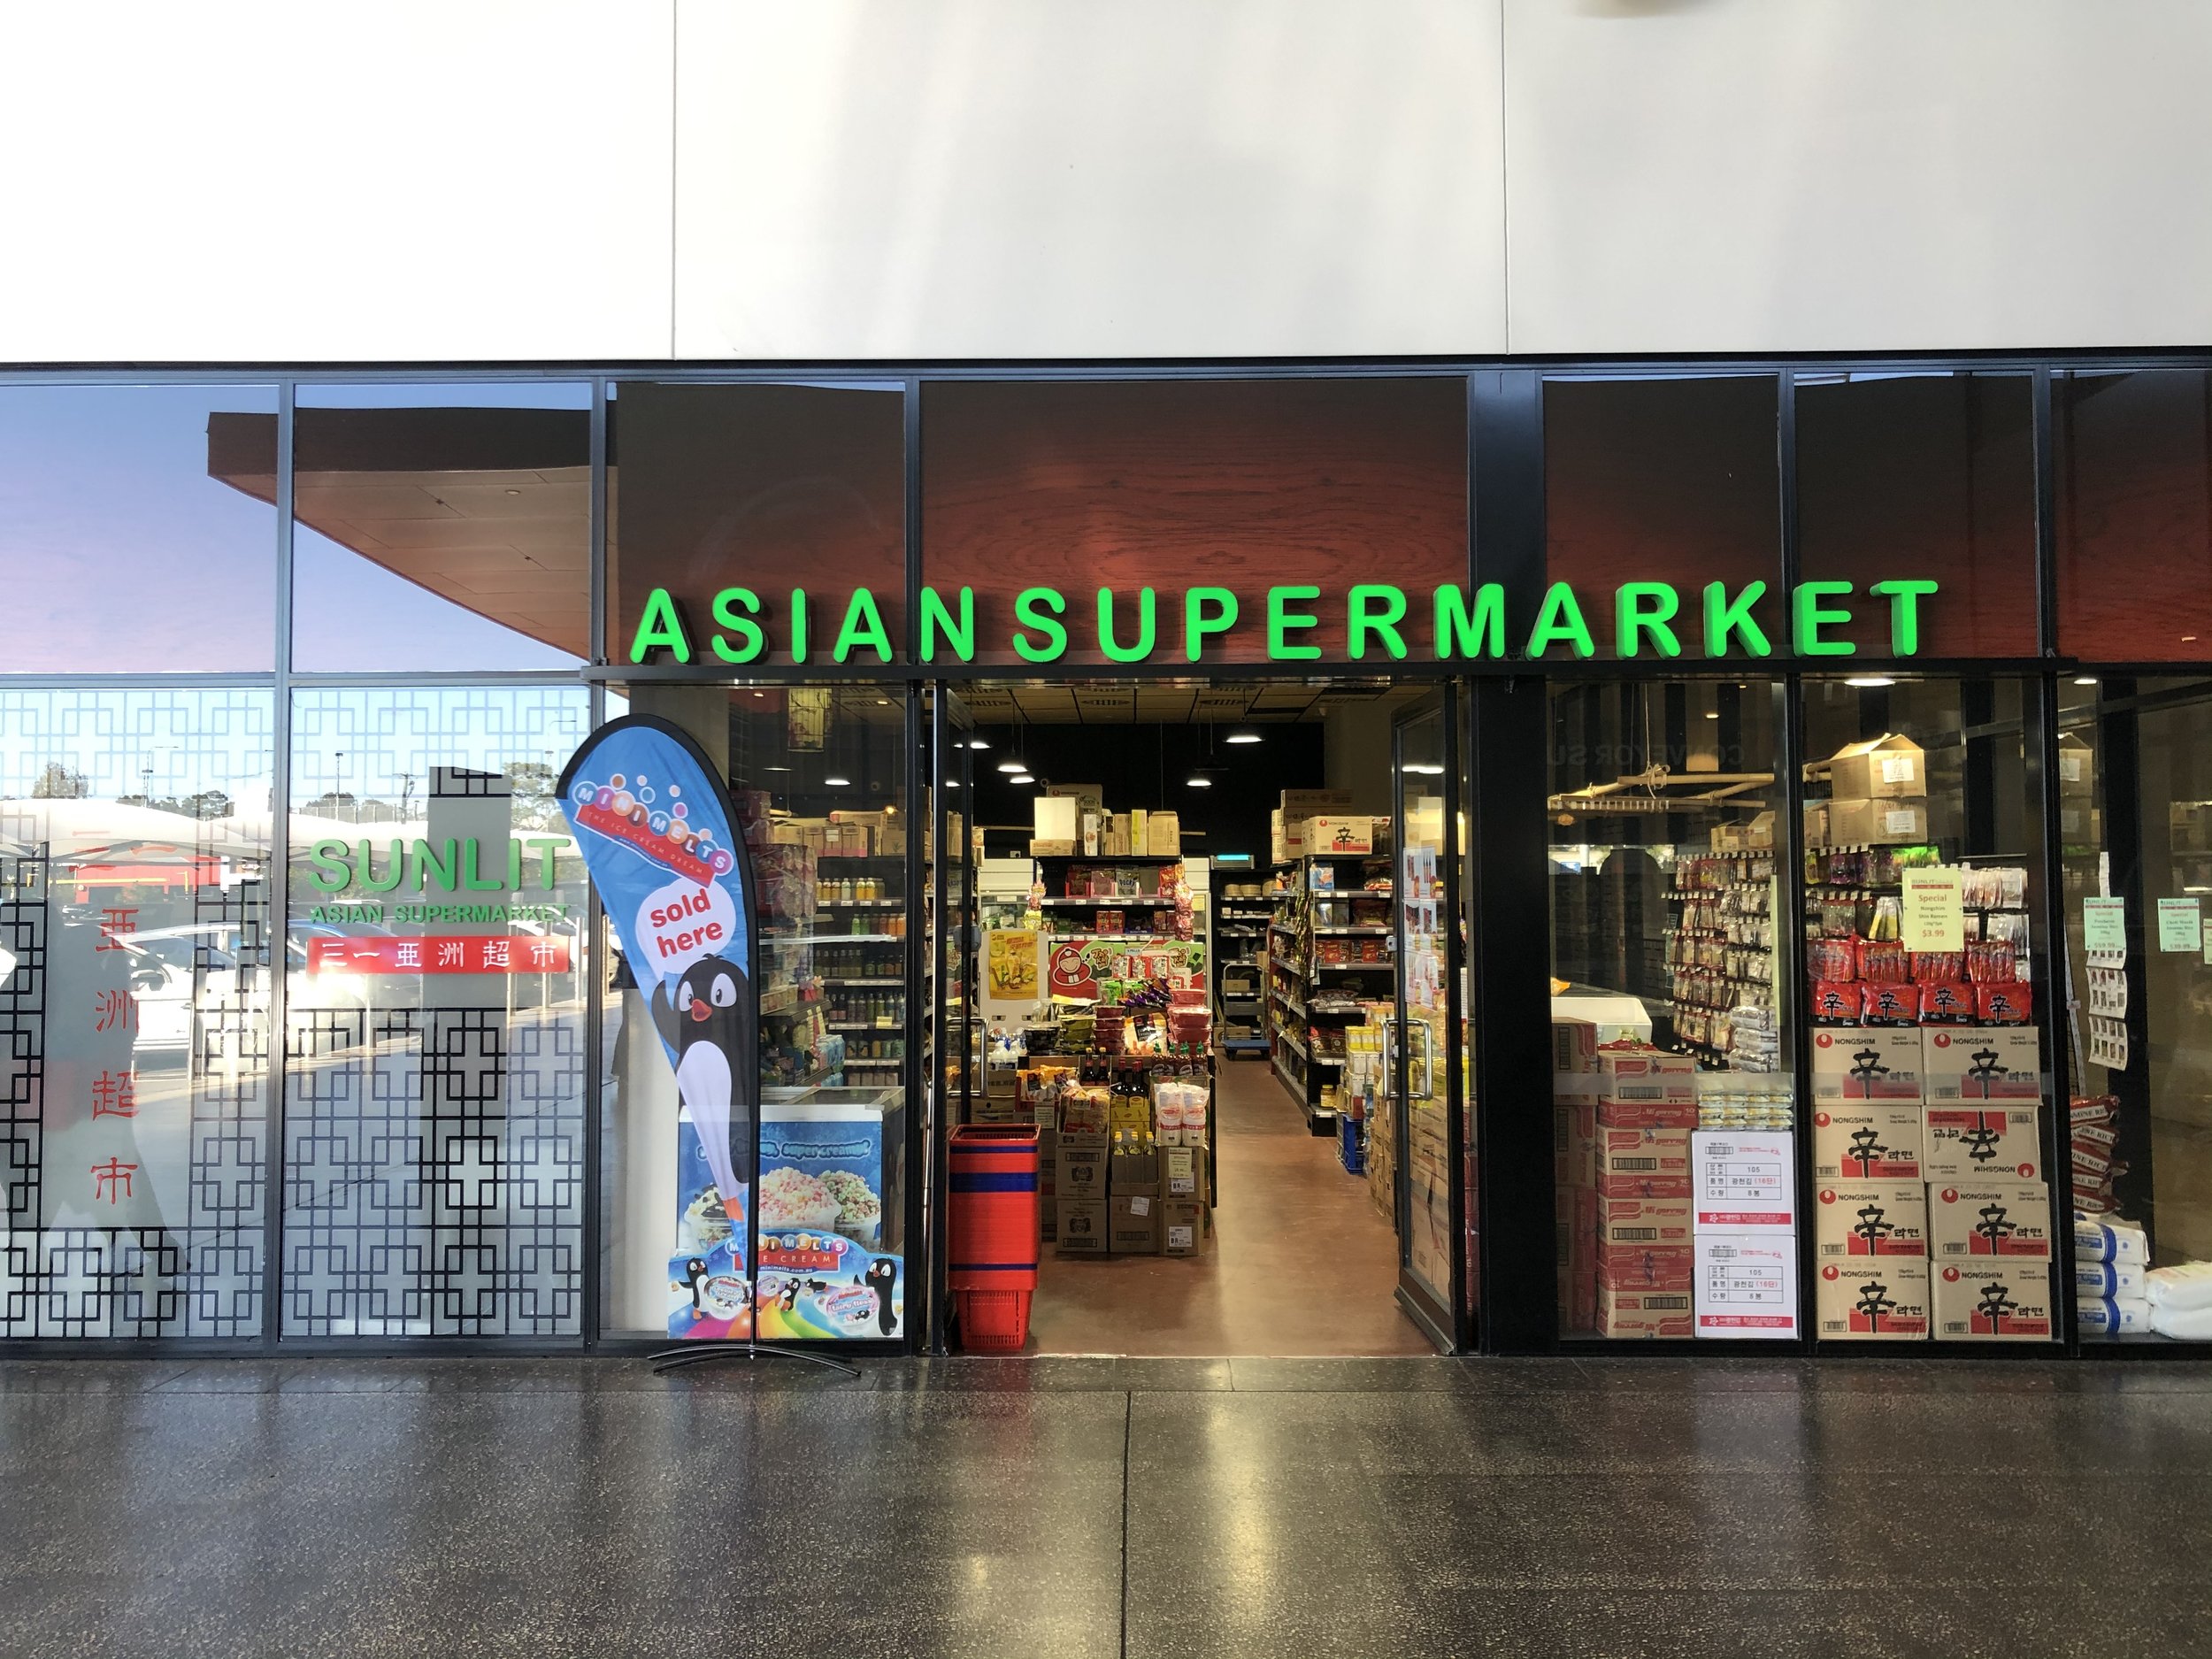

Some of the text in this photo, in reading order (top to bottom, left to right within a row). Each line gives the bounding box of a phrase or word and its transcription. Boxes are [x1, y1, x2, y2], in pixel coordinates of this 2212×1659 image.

[629, 580, 1939, 664] ASIAN SUPERMARKET
[310, 837, 571, 893] SUNLIT
[633, 833, 664, 855] CREAM
[670, 853, 703, 874] DREAM
[311, 903, 571, 924] ASIAN SUPERMARKET
[650, 887, 711, 929] sold
[1918, 894, 1947, 902] Special
[656, 921, 724, 958] here
[1922, 929, 1945, 938] $3.99
[1823, 990, 1845, 1021] 辛
[1878, 990, 1901, 1021] 辛
[1934, 987, 1956, 1018] 辛
[1988, 994, 2011, 1024] 辛
[1849, 1048, 1890, 1100] 辛
[1968, 1047, 2008, 1100] 辛
[1932, 1127, 1960, 1139] 라면
[1958, 1110, 2001, 1163] 辛
[1847, 1126, 1889, 1179] 辛
[1887, 1150, 1914, 1161] 라면
[1854, 1203, 1894, 1256] 辛
[1893, 1227, 1920, 1239] 라면
[1976, 1202, 2017, 1256] 辛
[2016, 1226, 2043, 1239] 라면
[780, 1255, 831, 1263] CREAM
[1855, 1280, 1897, 1333] 辛
[1896, 1305, 1923, 1317] 라면
[1977, 1281, 2018, 1335] 辛
[2017, 1306, 2044, 1318] 라면
